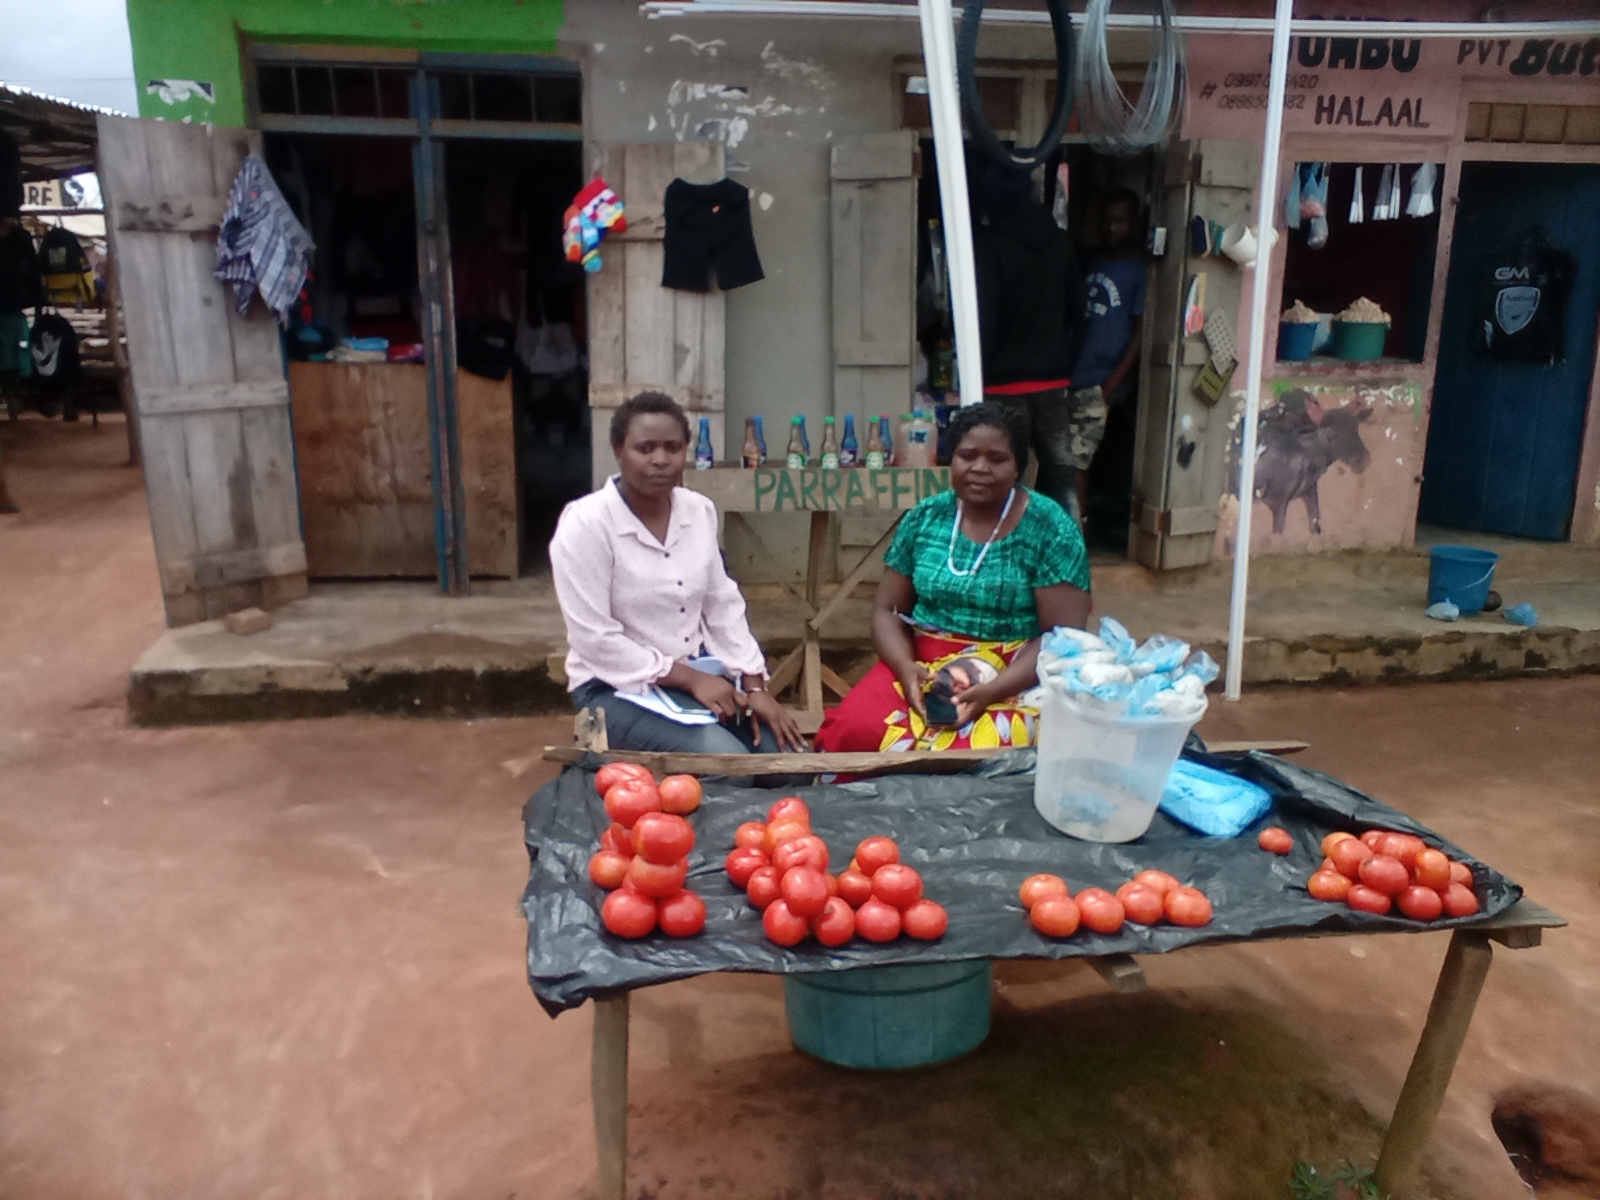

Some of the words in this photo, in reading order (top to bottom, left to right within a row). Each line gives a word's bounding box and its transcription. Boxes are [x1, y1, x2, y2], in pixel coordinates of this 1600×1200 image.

[1457, 39, 1511, 66] PVT
[1314, 94, 1430, 128] HALAAL
[754, 468, 951, 511] PARRAFFIN
